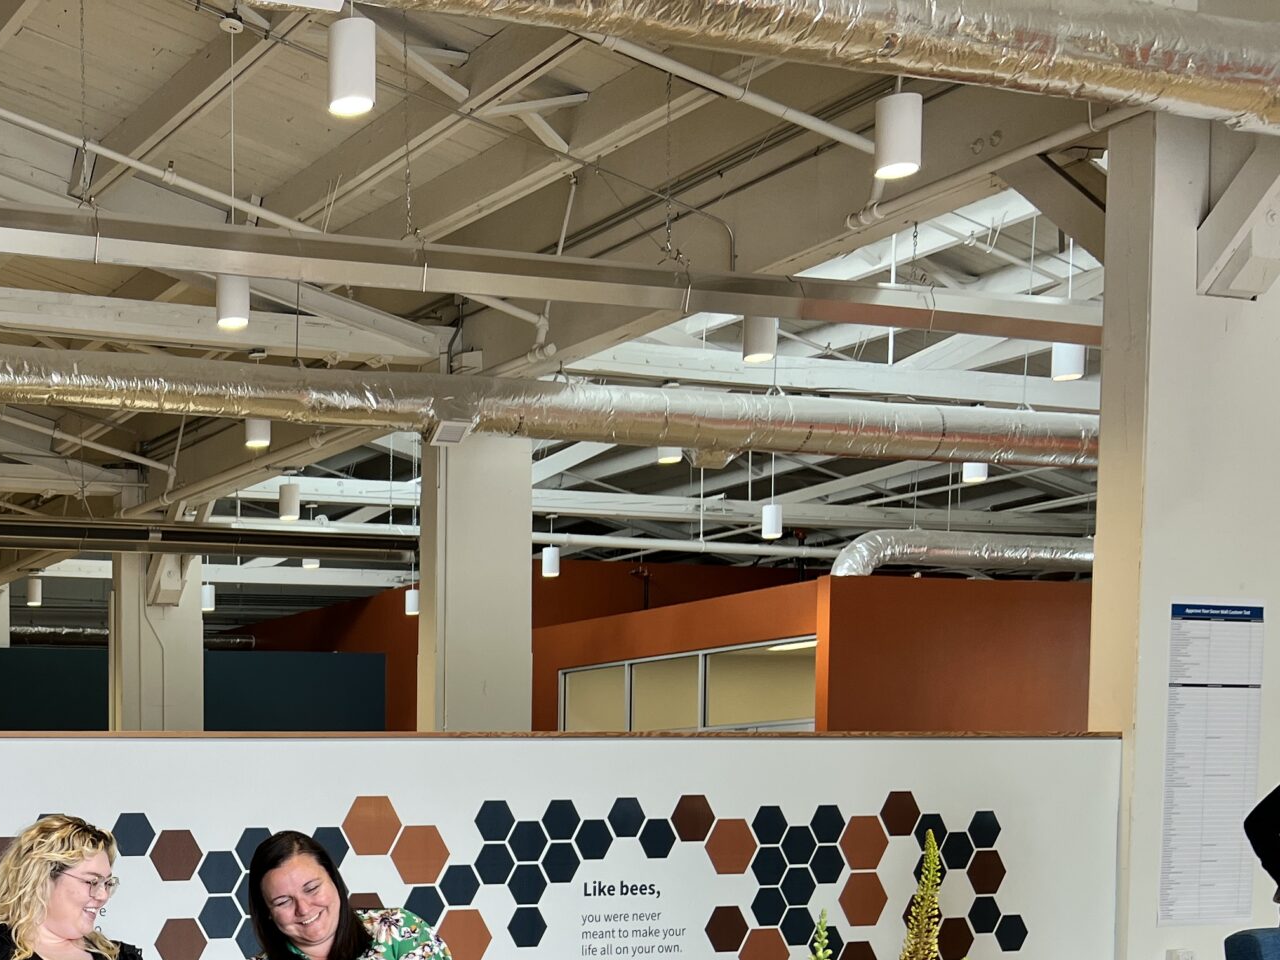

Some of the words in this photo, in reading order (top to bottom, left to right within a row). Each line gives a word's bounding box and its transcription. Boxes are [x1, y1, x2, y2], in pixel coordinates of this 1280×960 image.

[583, 880, 616, 897] Like
[619, 880, 661, 898] bees,
[581, 913, 601, 926] you
[604, 912, 630, 923] were
[632, 911, 662, 921] never
[581, 928, 616, 940] meant
[618, 927, 629, 939] to
[631, 926, 661, 938] make
[662, 927, 687, 941] your
[581, 944, 598, 956] life
[600, 943, 613, 956] all
[615, 945, 629, 955] on
[631, 945, 656, 957] your
[657, 944, 683, 954] own.
